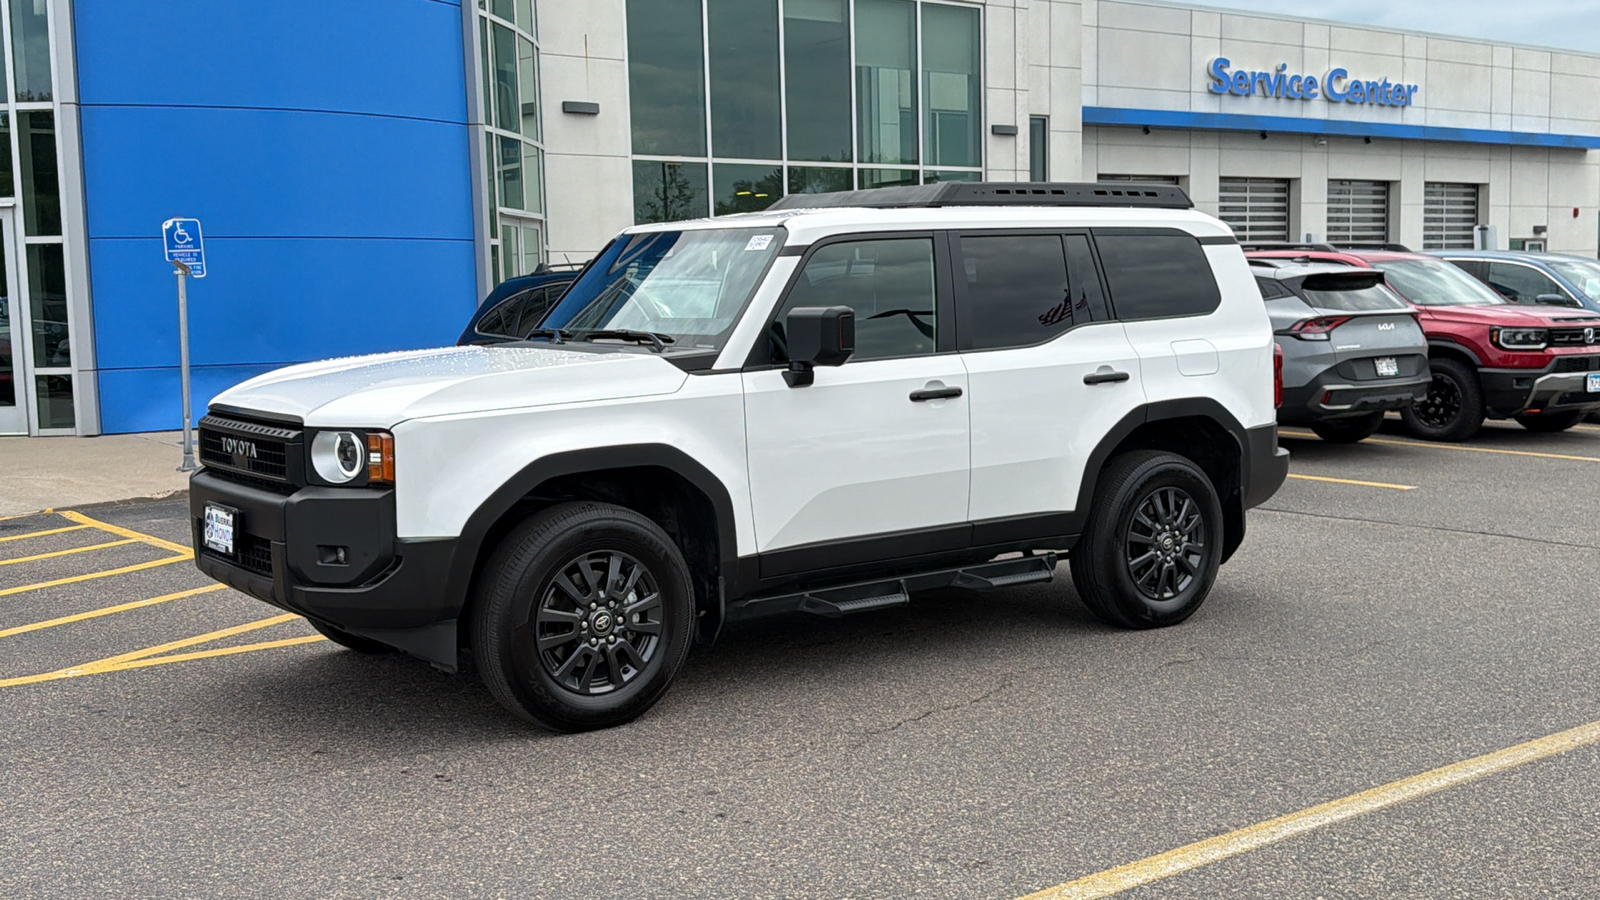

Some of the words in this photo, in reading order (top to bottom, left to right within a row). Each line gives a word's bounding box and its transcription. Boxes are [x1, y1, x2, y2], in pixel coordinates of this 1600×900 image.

[1208, 57, 1319, 99] Service
[1322, 67, 1419, 107] Center
[1377, 323, 1395, 331] KIA
[221, 437, 258, 459] TOYOTA
